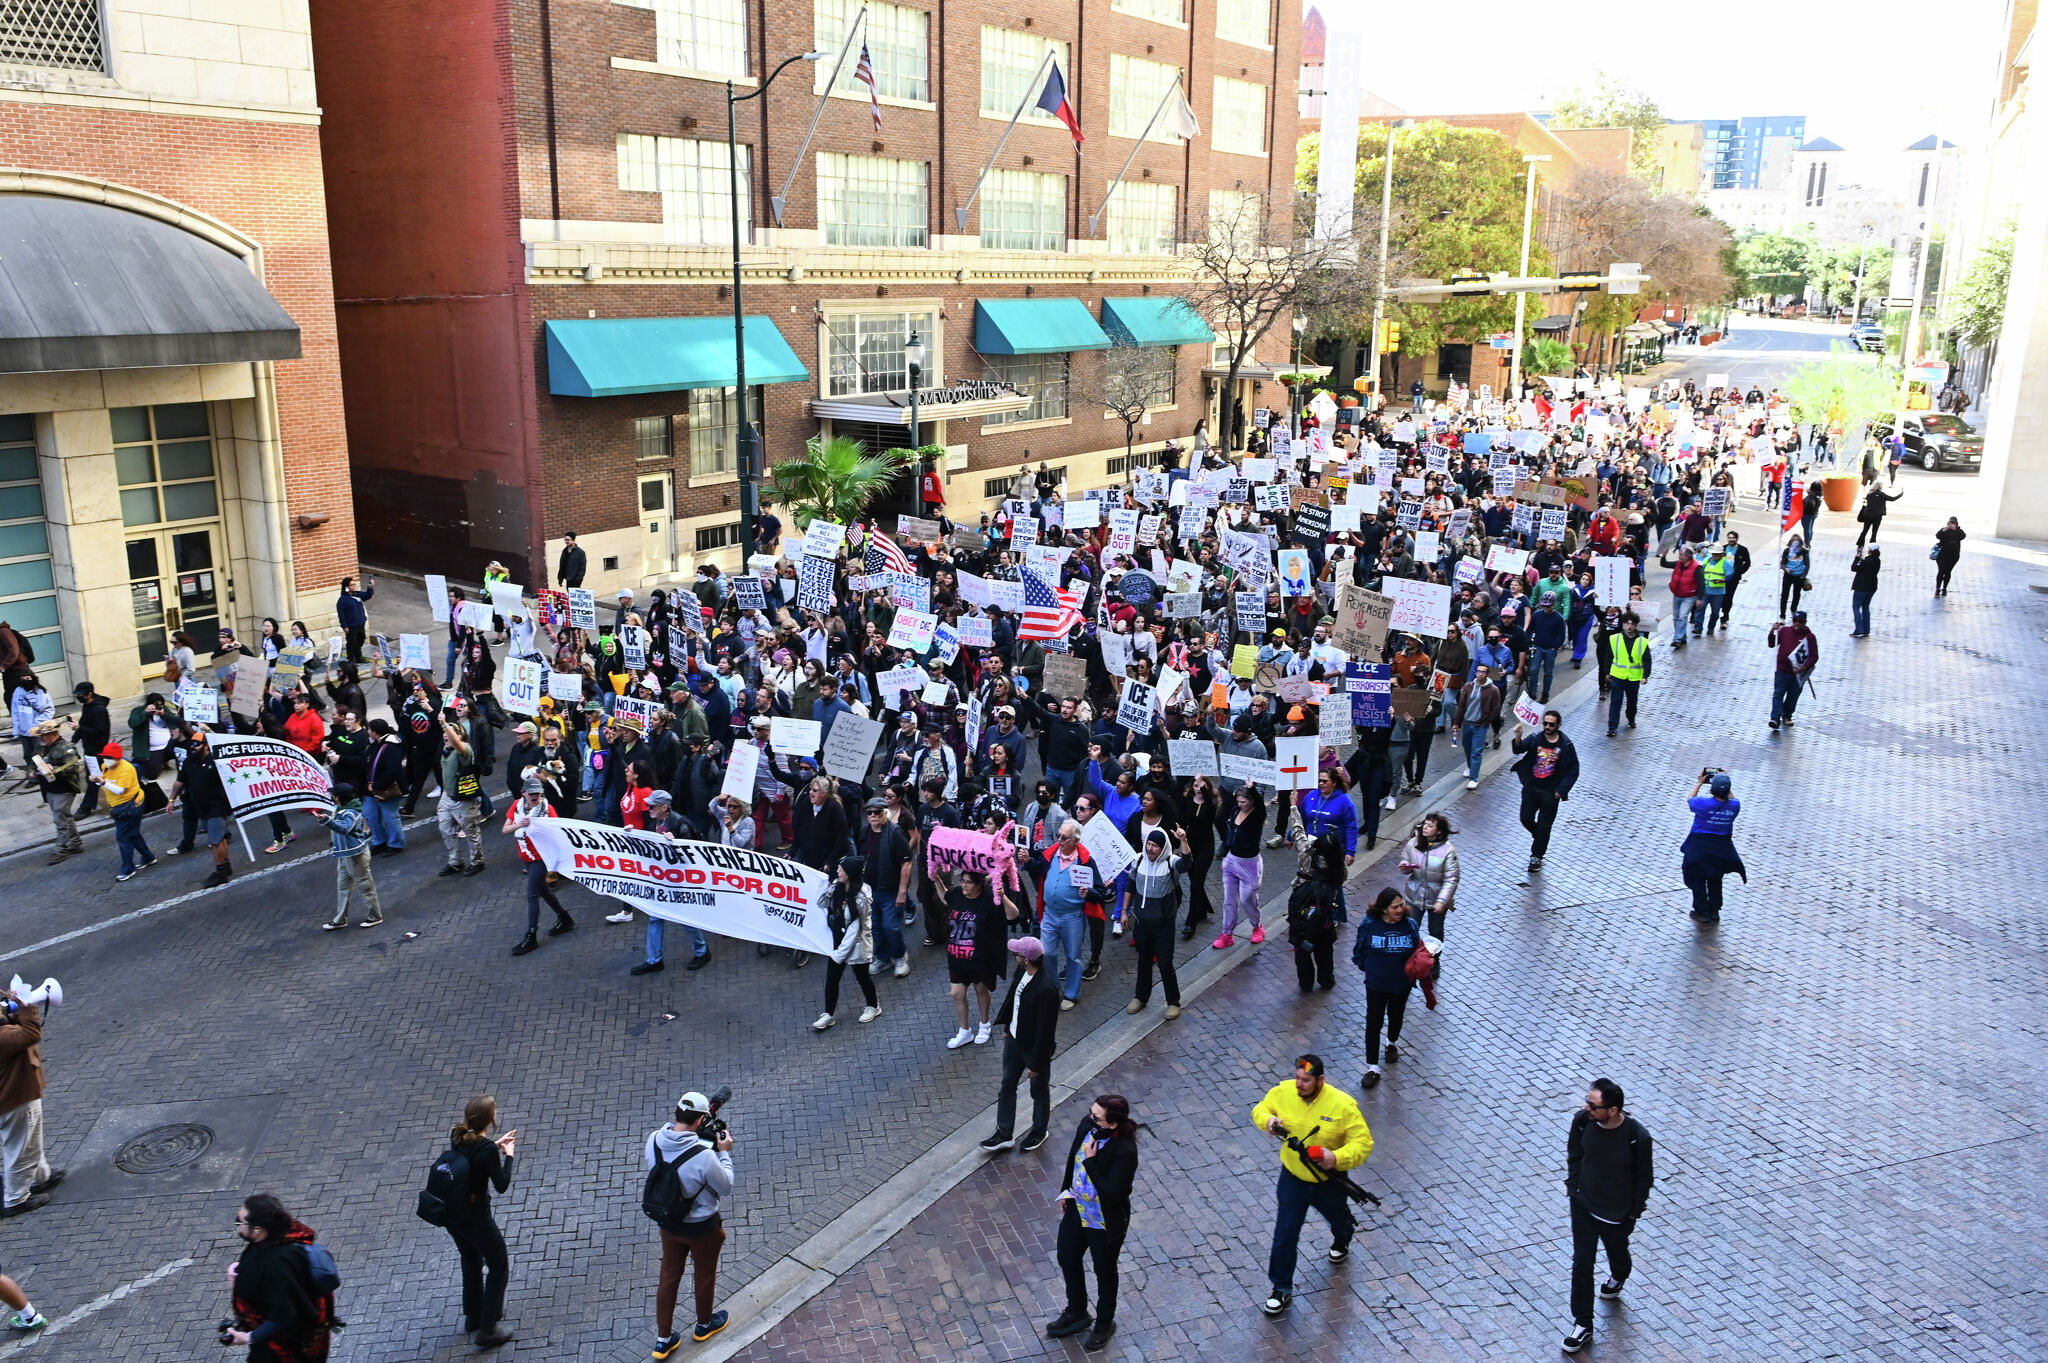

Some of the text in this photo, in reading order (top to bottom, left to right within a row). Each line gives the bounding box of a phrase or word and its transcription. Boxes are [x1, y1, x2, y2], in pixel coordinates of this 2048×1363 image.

[1329, 39, 1356, 232] HOMEWOO
[917, 385, 1000, 405] OMEWOOD SUITES
[1431, 445, 1448, 457] STOP
[1107, 490, 1119, 502] ICE
[1292, 488, 1319, 498] ABOLISH
[1012, 501, 1024, 514] ICE
[1300, 504, 1328, 519] DESTROY
[1400, 502, 1421, 515] STOP
[1297, 515, 1327, 530] AMERICAN
[1543, 515, 1565, 525] NEEDS
[1295, 525, 1320, 538] FASCISM
[1112, 541, 1130, 550] OUT
[802, 563, 833, 579] FUCK ICE
[804, 556, 834, 572] FUCK ICE
[801, 571, 832, 586] FUCK ICE
[1252, 568, 1265, 577] TOP
[735, 583, 760, 592] NO U.S.
[801, 578, 831, 593] FUCK ICE
[895, 573, 930, 588] ABOLISH
[800, 584, 830, 599] FUCK ICE
[900, 584, 922, 598] ICE
[1362, 588, 1372, 598] WHO
[1400, 581, 1428, 597] ICE
[798, 592, 830, 615] FUCK ICE
[915, 600, 929, 613] ICE
[1345, 594, 1391, 621] REMEMBER
[897, 614, 931, 631] OBEY DIE
[1247, 619, 1265, 627] TERROR
[1391, 611, 1443, 632] URDERERS
[624, 626, 639, 647] ICE
[669, 627, 686, 649] STOP
[960, 635, 988, 646] MURDER
[1334, 631, 1372, 649] ARE CONDEMNED
[1346, 628, 1372, 642] THE PAST
[1341, 641, 1368, 657] REPEAT IT
[512, 664, 534, 683] ICE
[877, 668, 917, 680] VETERANS
[1356, 662, 1379, 673] ICE
[882, 676, 916, 687] AGAINST
[1347, 680, 1390, 692] TERRORISTS
[509, 682, 534, 700] OUT
[1128, 681, 1150, 707] ICE
[1326, 693, 1346, 702] ICE
[1361, 694, 1375, 702] WE
[617, 698, 629, 711] NO
[630, 701, 646, 714] ONE
[1123, 703, 1147, 719] OUT OF OUR
[1320, 703, 1349, 712] BELONGS
[1358, 703, 1378, 711] WILL
[1119, 710, 1149, 727] COMMUNITIES
[1353, 710, 1386, 719] RESIST
[241, 743, 273, 754] FUERA
[273, 744, 286, 755] DE
[561, 827, 805, 883] U.S. HANDS OFF VENEZUELA
[930, 844, 968, 870] FUCK
[1111, 840, 1130, 862] small
[574, 853, 808, 905] NO BLOOD FOR OIL
[574, 876, 716, 907] PARTY FOR SOCIALISM & LIBERATION
[949, 919, 976, 941] OLD
